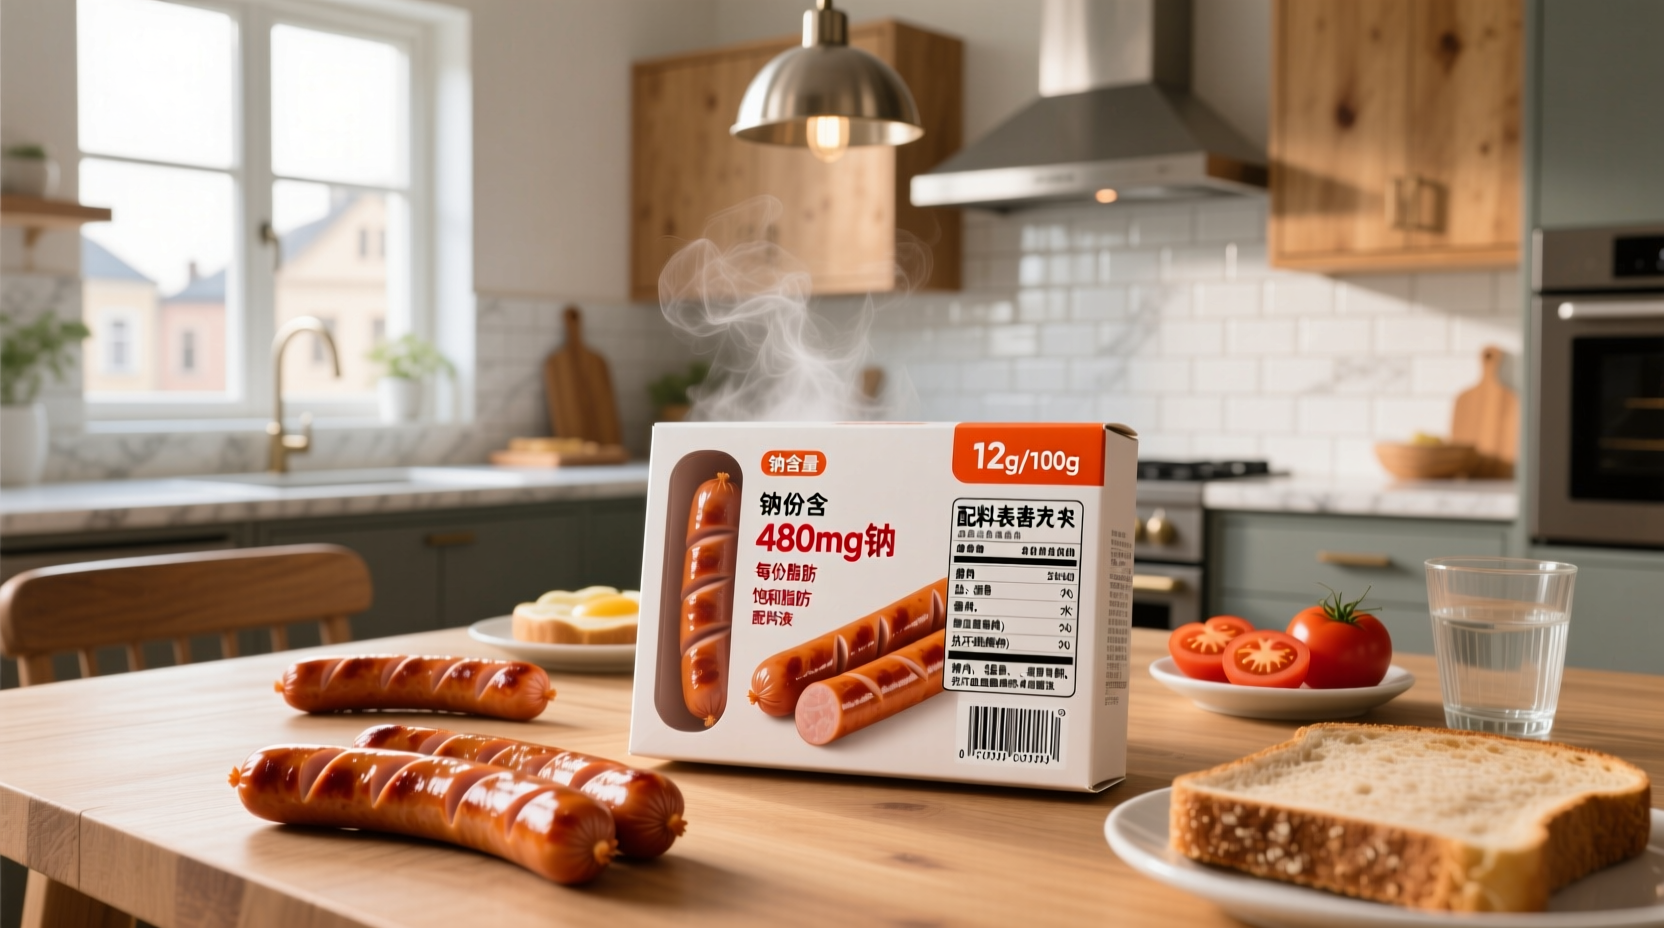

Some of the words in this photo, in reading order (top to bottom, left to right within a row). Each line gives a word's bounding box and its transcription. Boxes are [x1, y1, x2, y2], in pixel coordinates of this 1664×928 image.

[768, 453, 819, 473] 钠含量
[973, 441, 1080, 476] 12g/100g
[760, 491, 828, 517] 钠份含
[755, 522, 896, 562] 480mg钠
